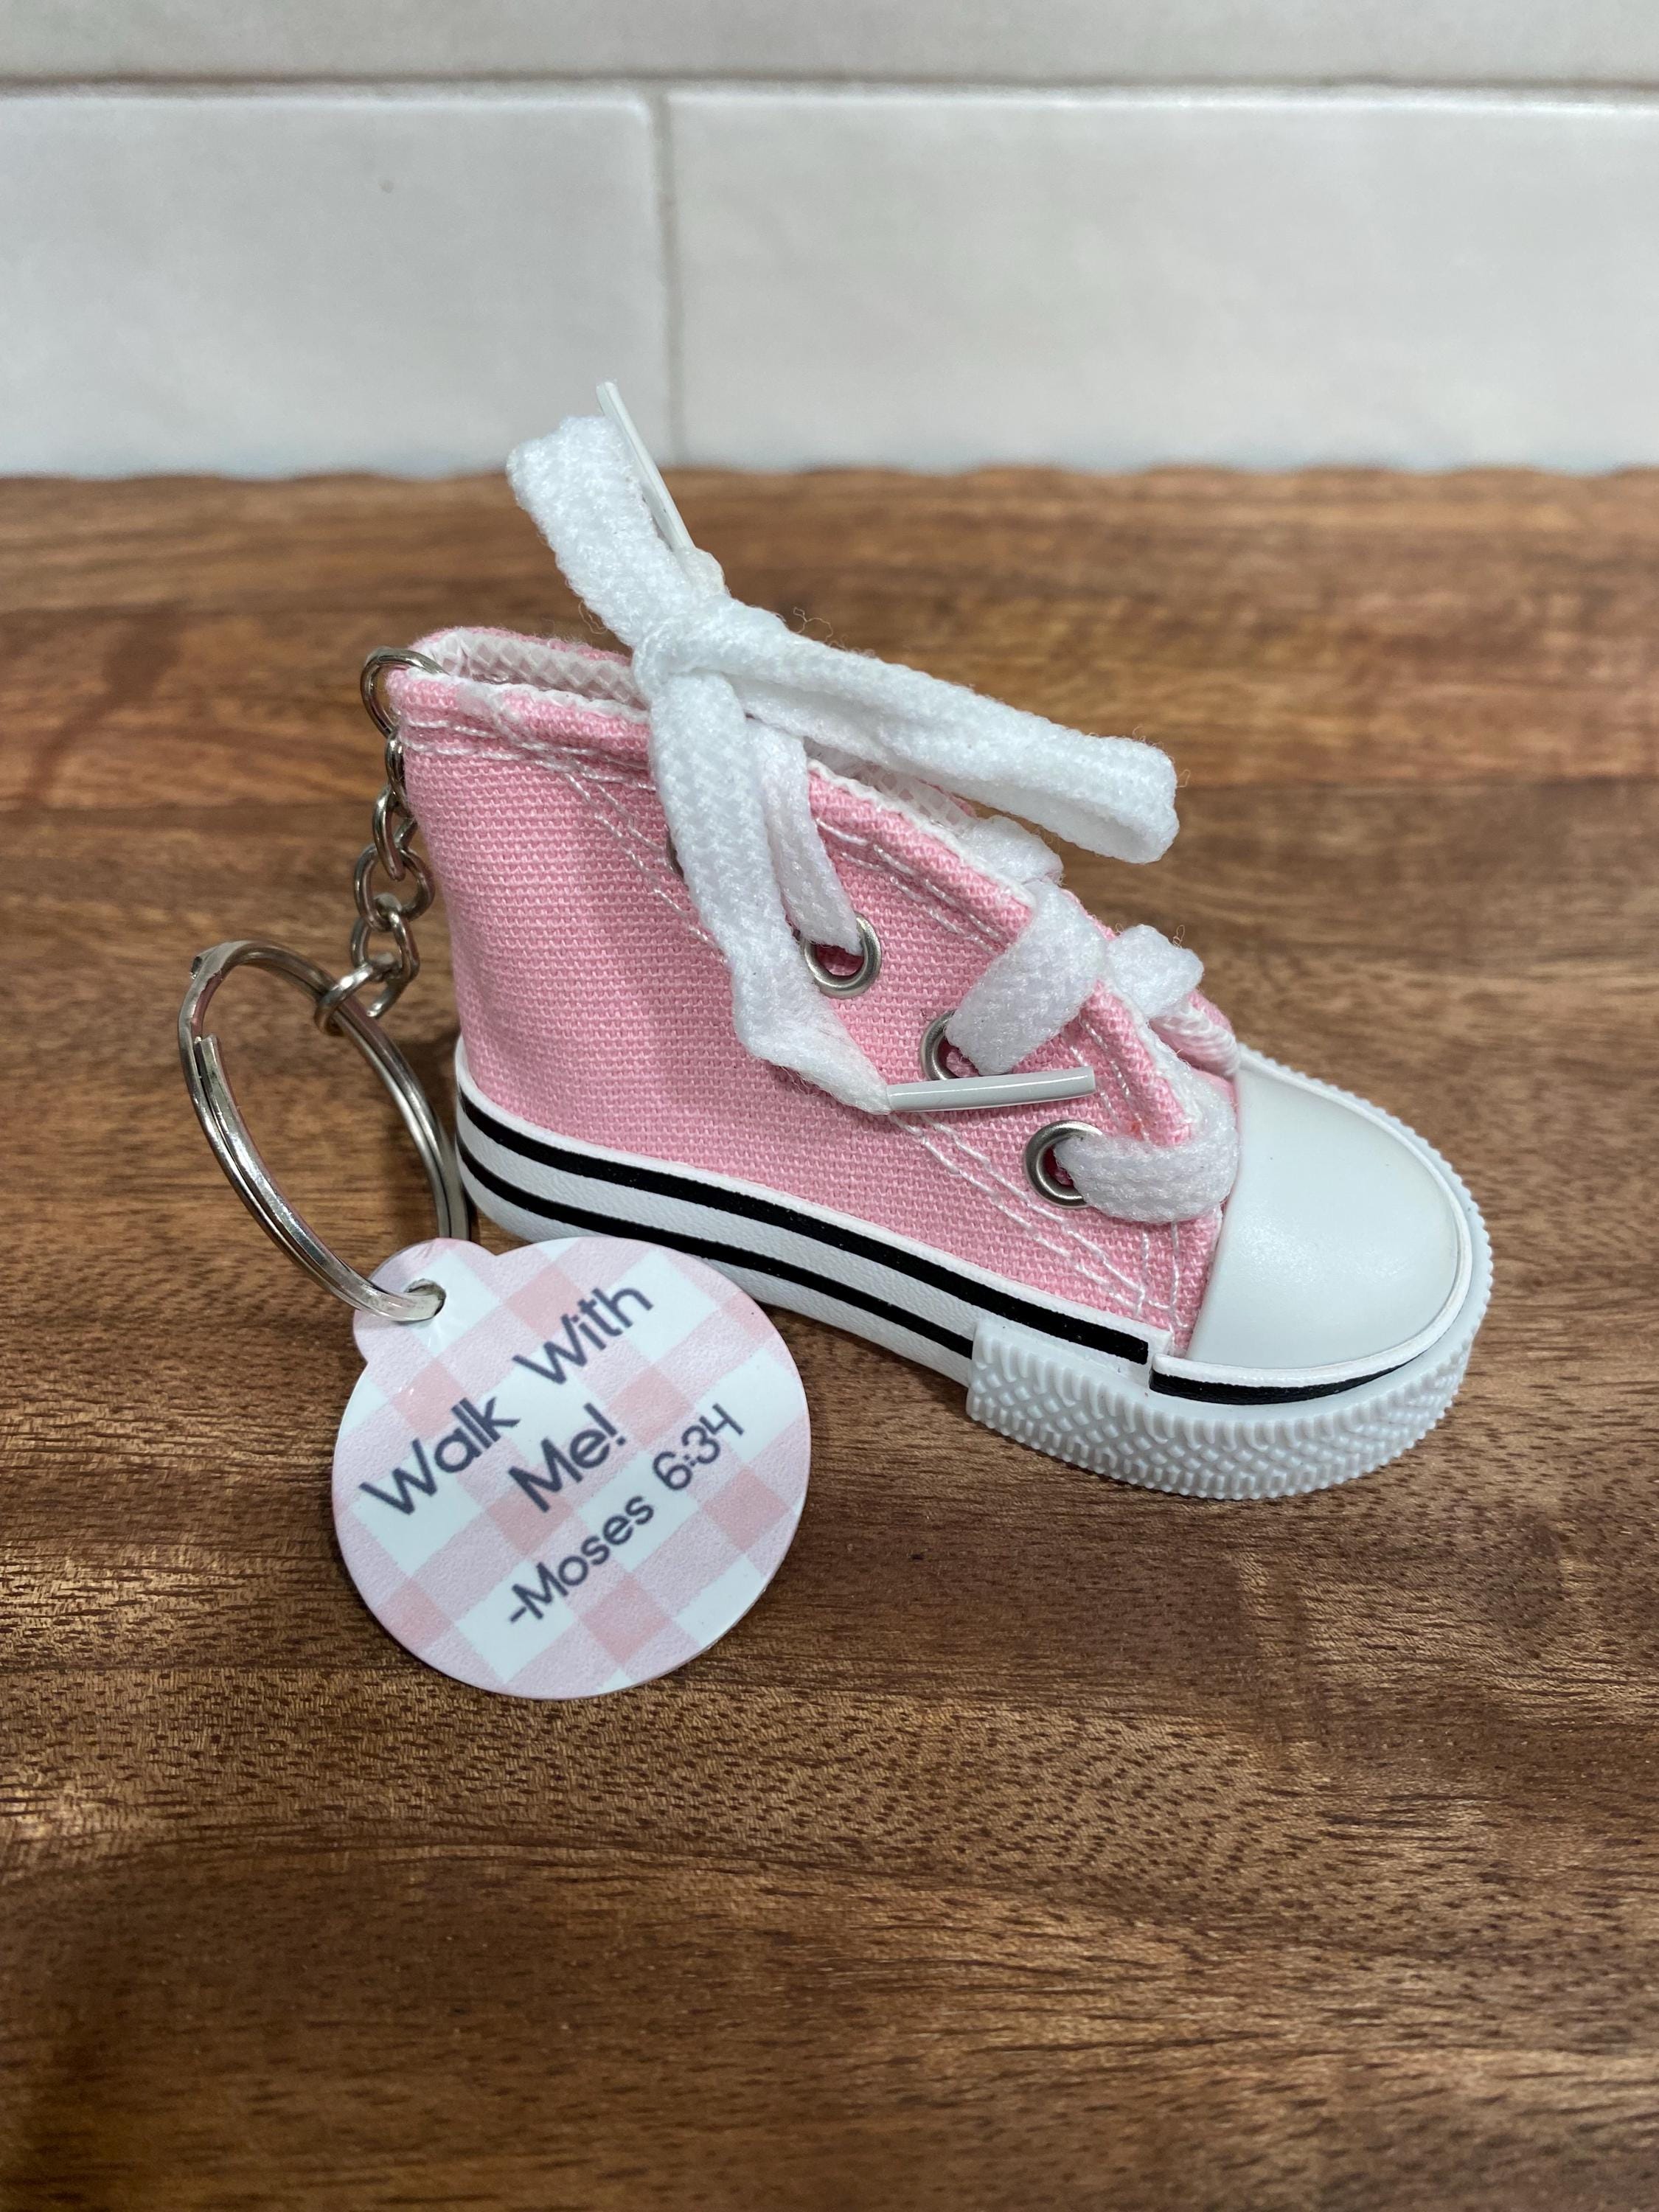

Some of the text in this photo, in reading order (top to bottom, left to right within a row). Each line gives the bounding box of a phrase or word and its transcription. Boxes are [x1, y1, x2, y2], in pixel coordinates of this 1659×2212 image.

[358, 1286, 654, 1516] Walk With
[507, 1402, 627, 1514] Me!
[508, 1402, 745, 1624] -Moses 6:34
